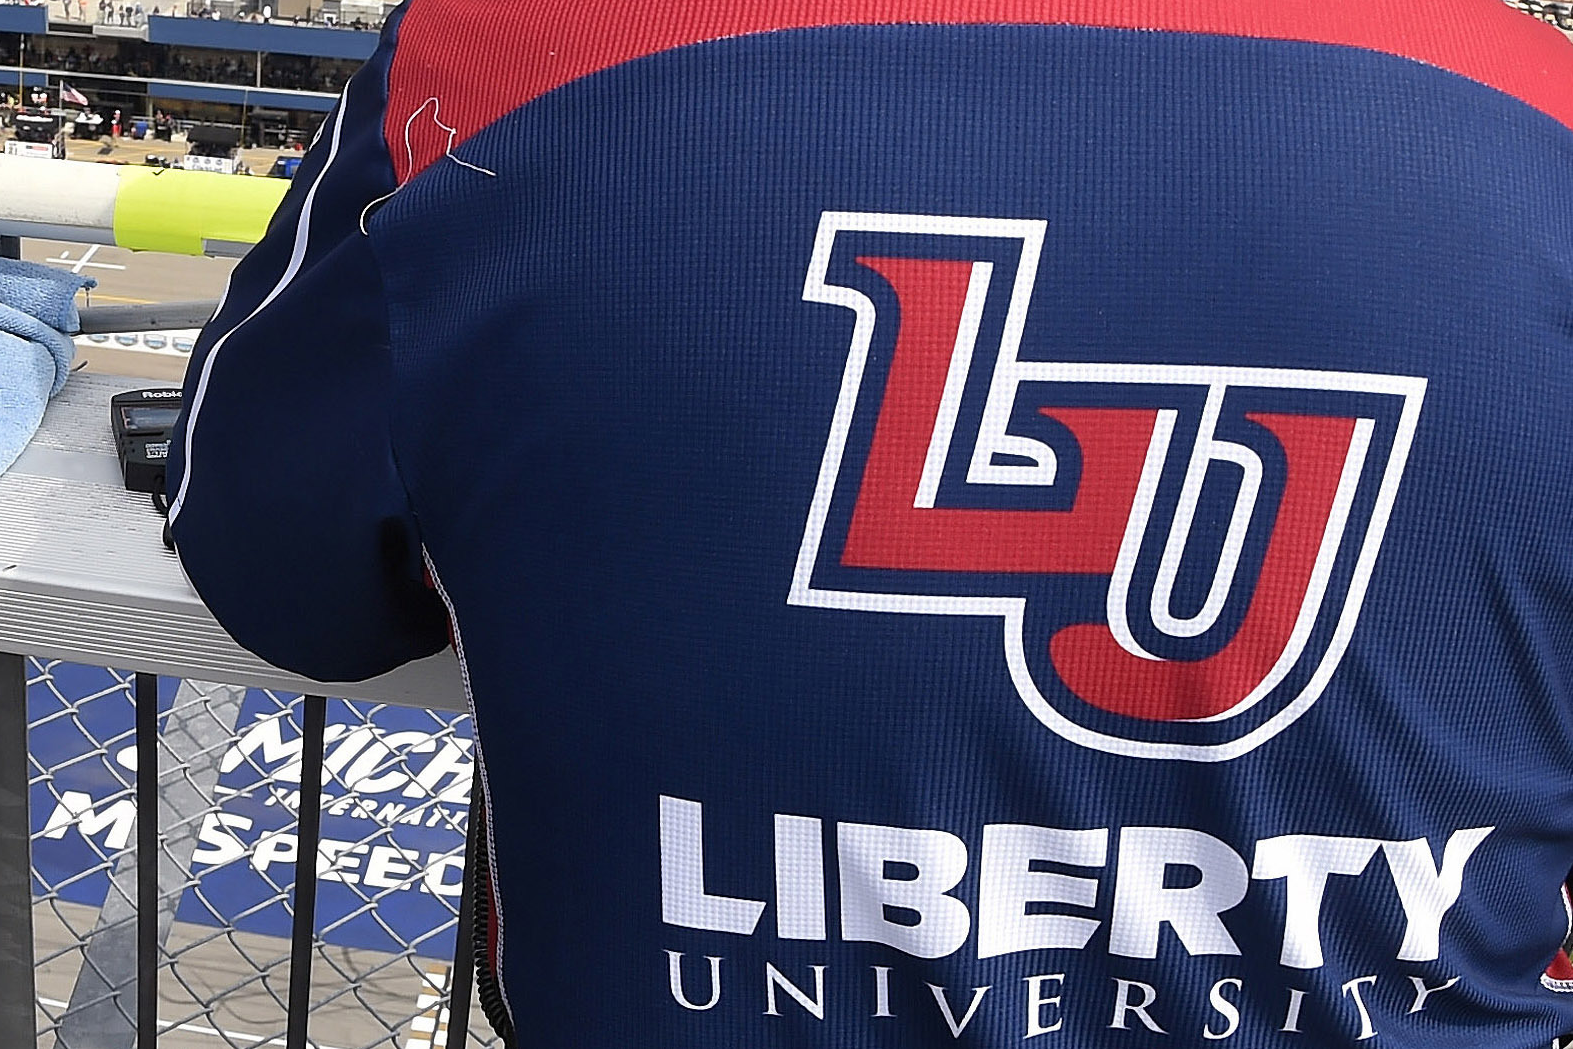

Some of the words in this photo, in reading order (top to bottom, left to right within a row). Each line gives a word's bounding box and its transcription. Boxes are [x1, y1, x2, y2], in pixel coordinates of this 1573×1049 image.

[220, 713, 473, 805] MICH
[192, 812, 466, 897] SPEED
[660, 794, 1495, 969] LIBERTY
[664, 950, 1462, 1041] UNIVERSITY
